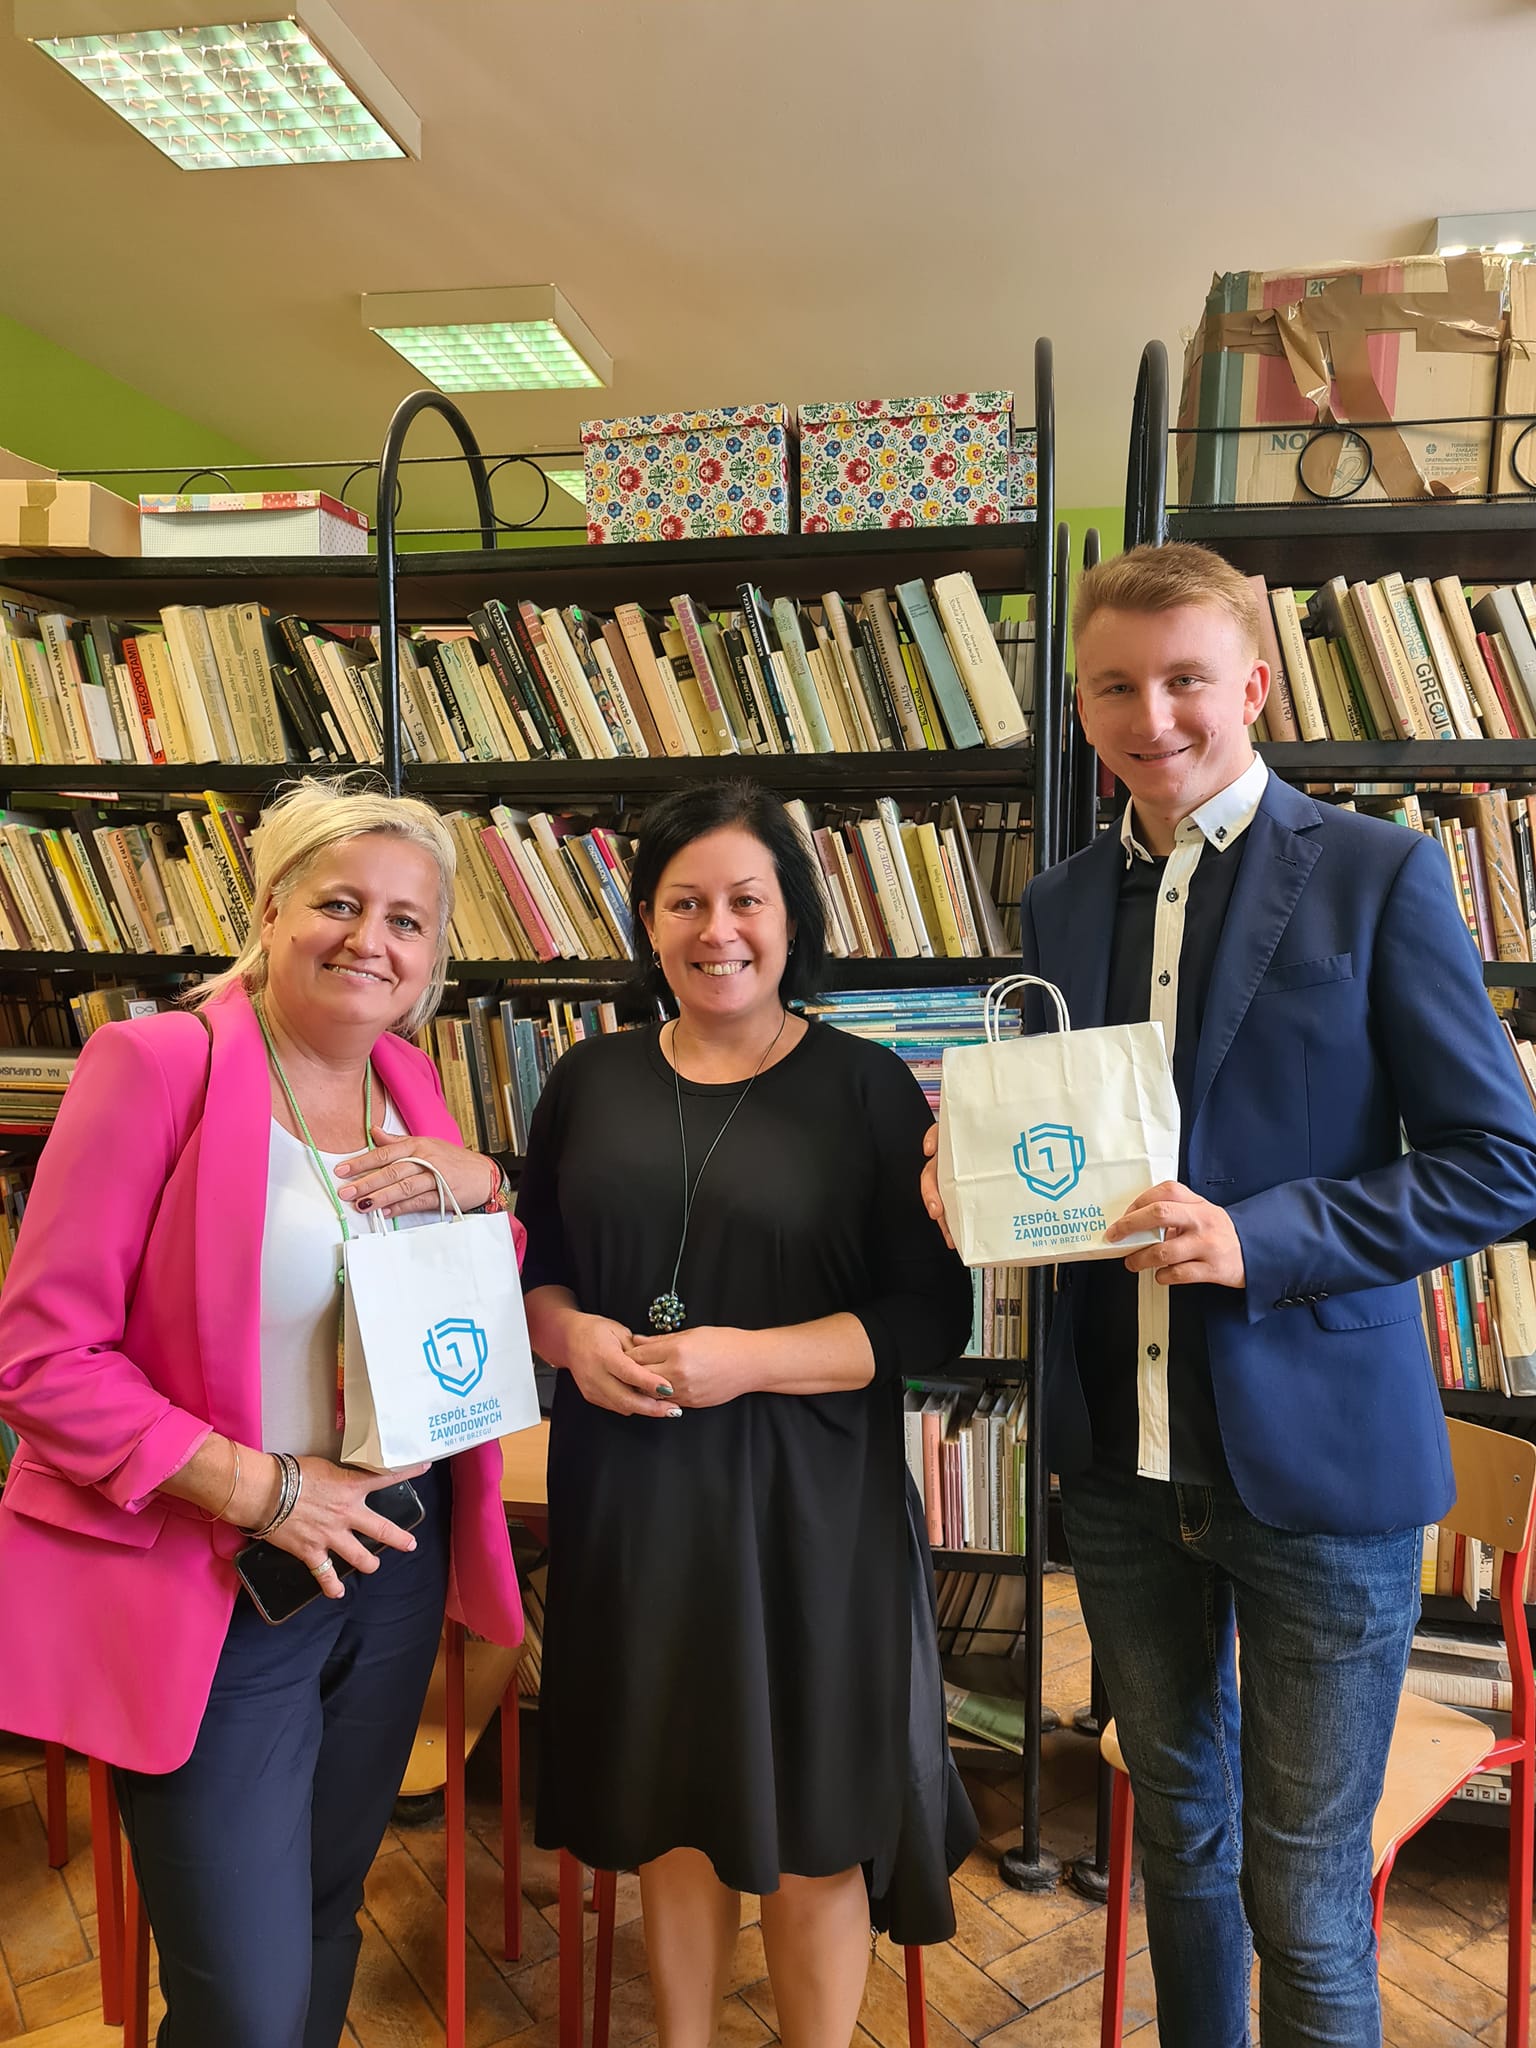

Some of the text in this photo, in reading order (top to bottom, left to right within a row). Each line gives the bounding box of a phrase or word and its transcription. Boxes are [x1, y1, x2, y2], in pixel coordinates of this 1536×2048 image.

[125, 641, 151, 715] MEZOPOTAMII
[431, 653, 455, 704] BIZANTYŃSKA
[614, 691, 629, 718] SZTUCE
[1414, 661, 1450, 730] GRECJI
[585, 843, 609, 883] Moniuszko
[870, 825, 896, 887] LUDZIE ŻYWI
[47, 1068, 59, 1076] NA
[1012, 1203, 1104, 1228] ZESPÓŁ SZKÓŁ
[1015, 1220, 1107, 1241] ZAWODOWYCH
[1050, 1237, 1058, 1245] W
[1060, 1234, 1092, 1244] BRZEGU
[428, 1397, 501, 1428] ZESPÓŁ SZKÓŁ
[430, 1411, 502, 1442] ZAWODOWYCH
[459, 1434, 466, 1443] W
[466, 1427, 492, 1441] BRZEGU
